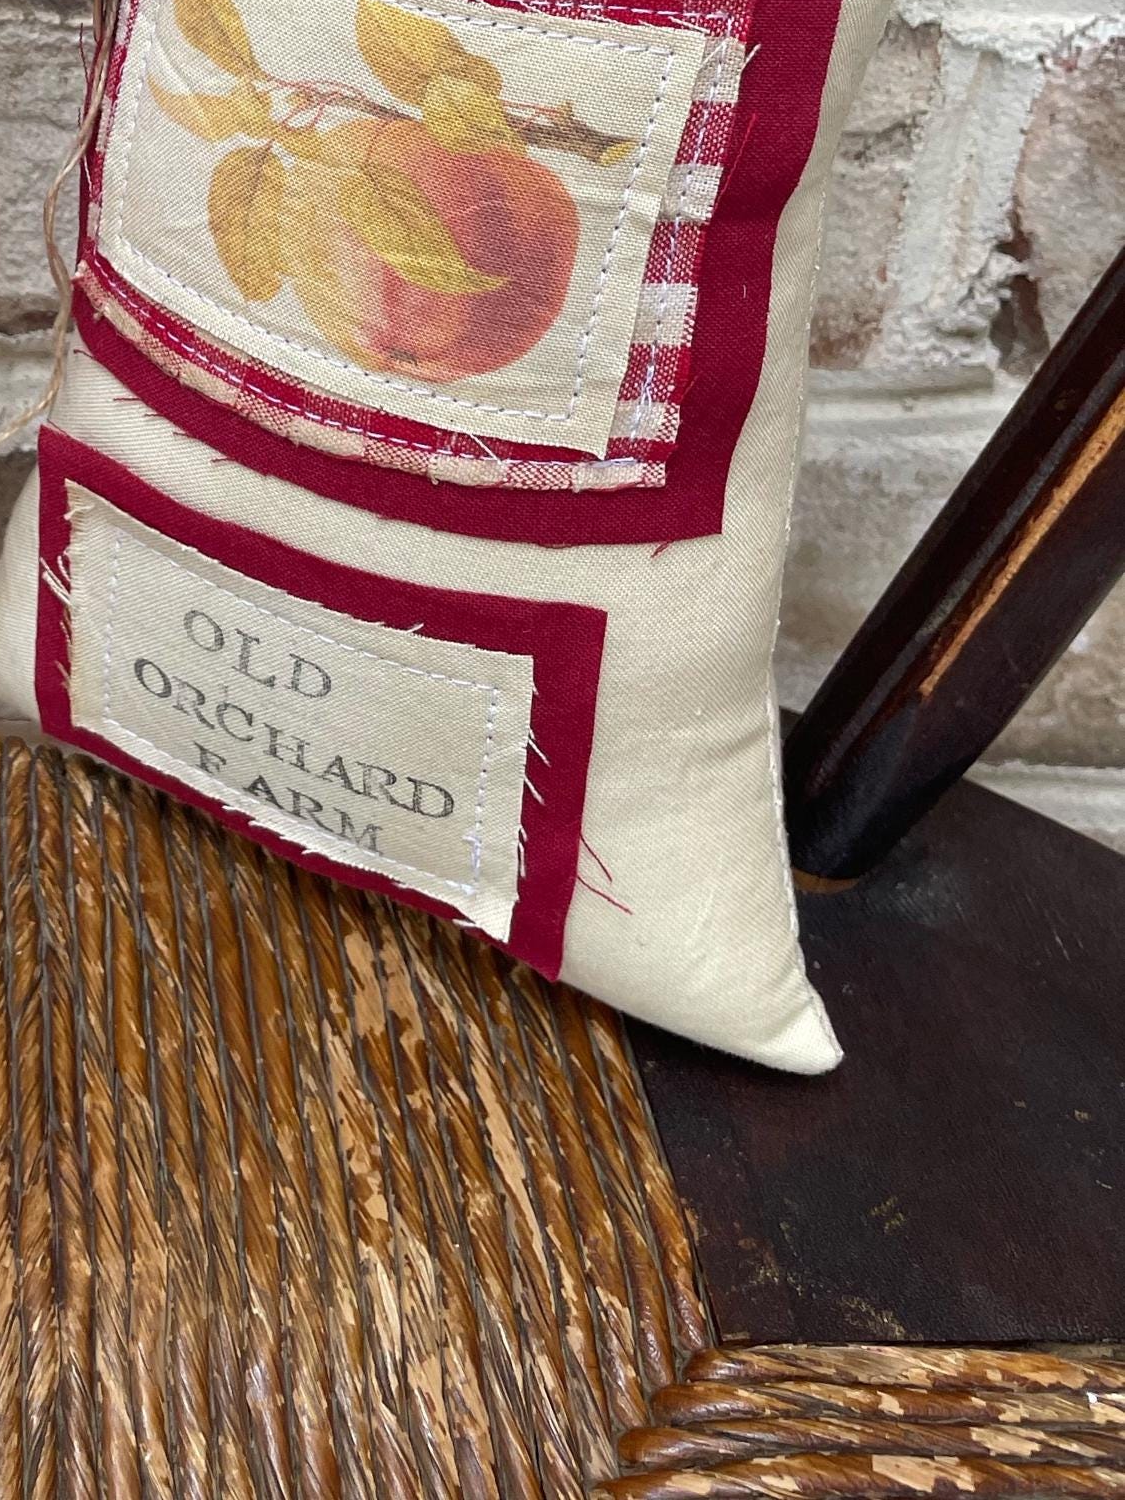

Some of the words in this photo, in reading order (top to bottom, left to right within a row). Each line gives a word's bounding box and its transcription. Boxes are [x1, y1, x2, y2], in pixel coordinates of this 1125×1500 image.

[183, 609, 332, 699] OLD
[134, 657, 455, 819] ORCHARD
[193, 742, 384, 857] FARM
